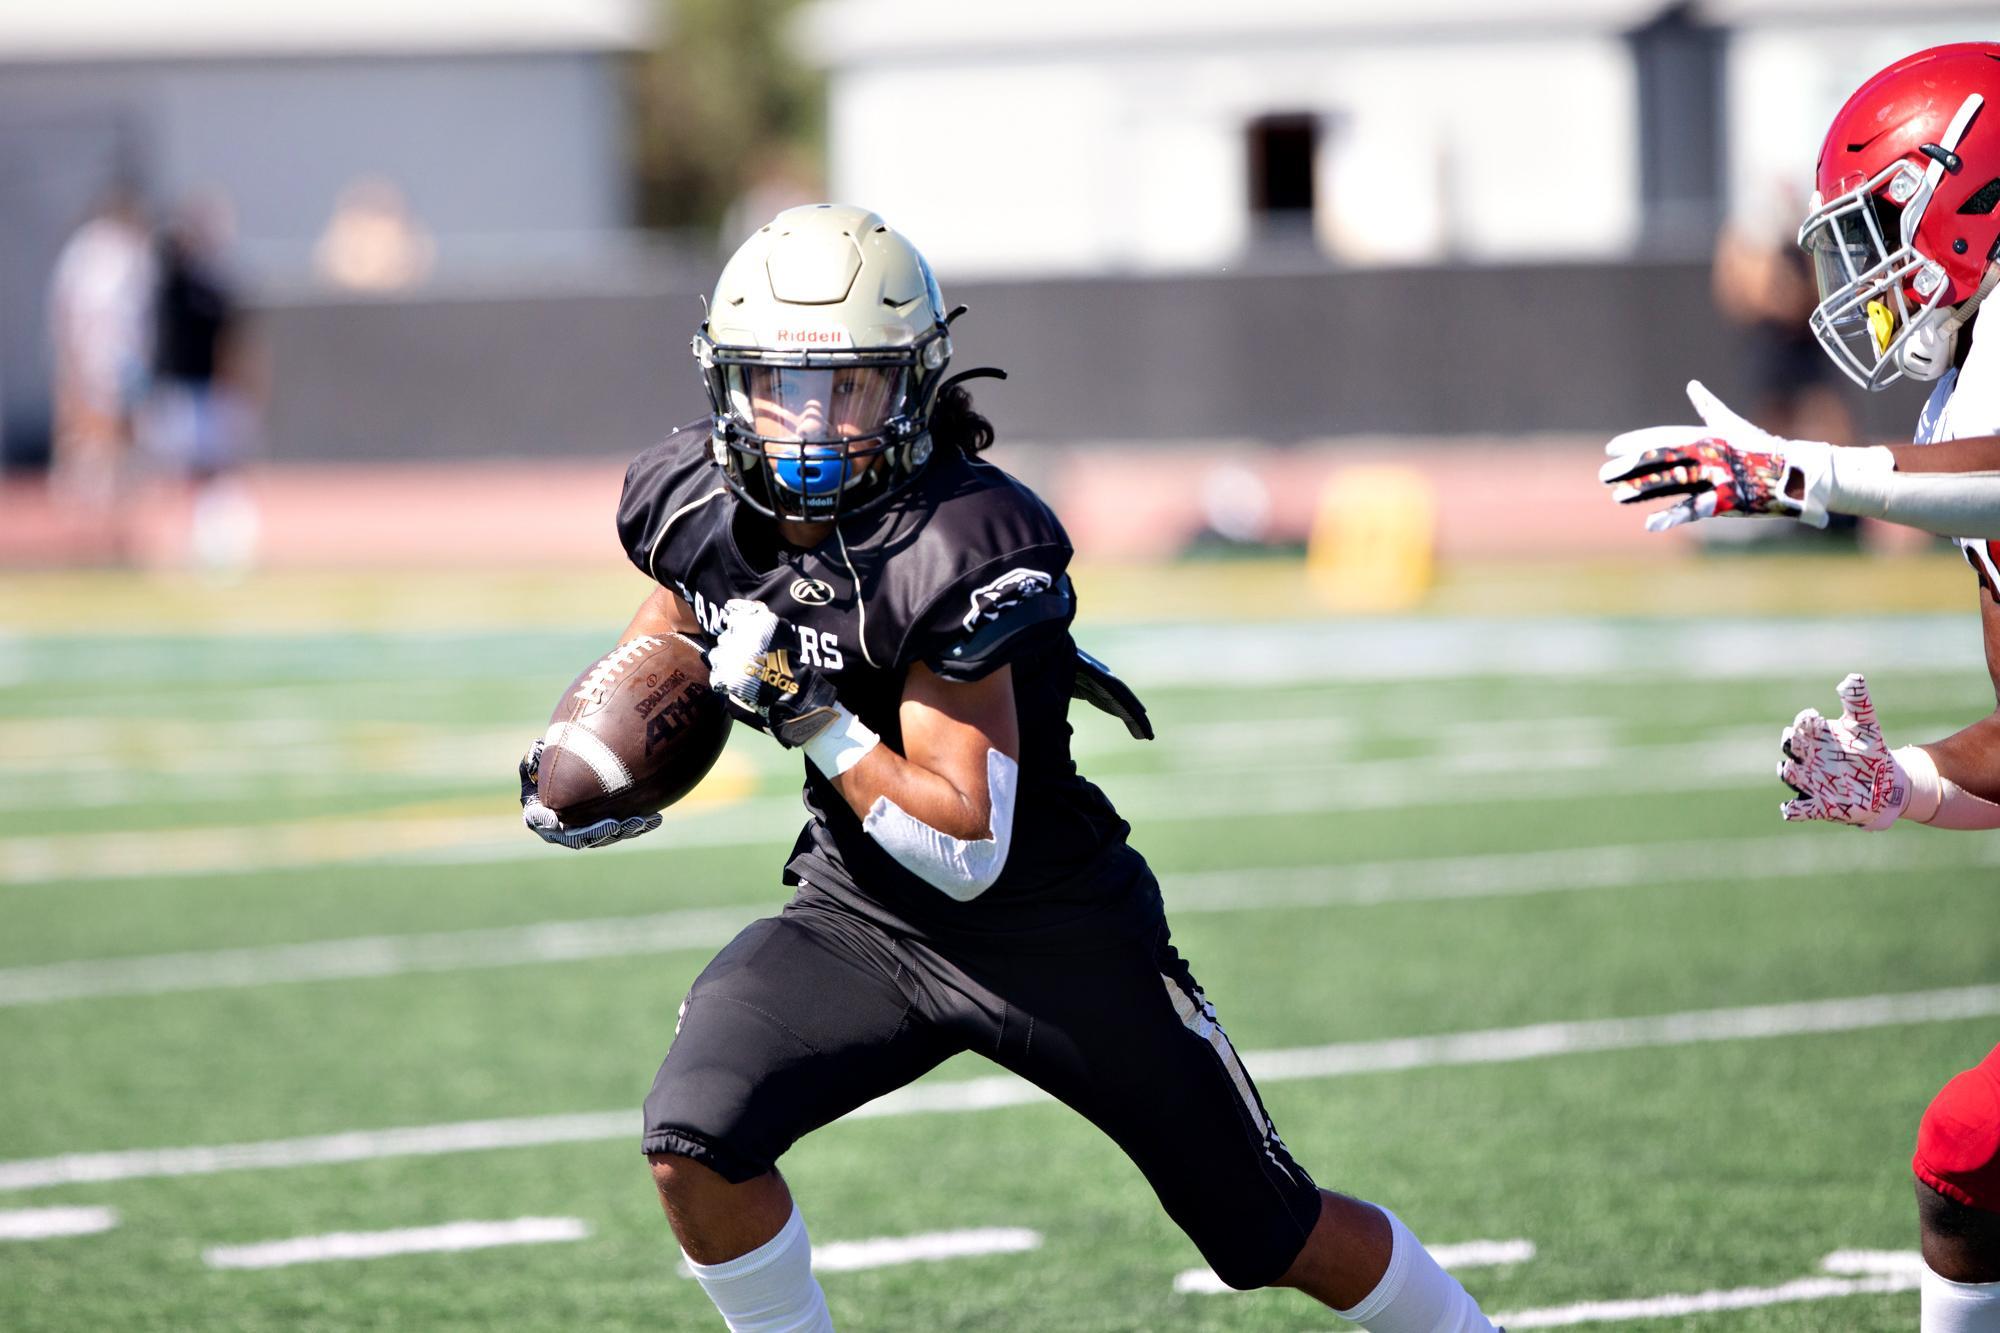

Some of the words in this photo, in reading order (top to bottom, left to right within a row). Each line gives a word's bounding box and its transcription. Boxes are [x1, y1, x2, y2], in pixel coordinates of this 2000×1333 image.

[777, 329, 841, 342] Riddell
[634, 668, 687, 720] SPALDING
[744, 663, 799, 695] adidas
